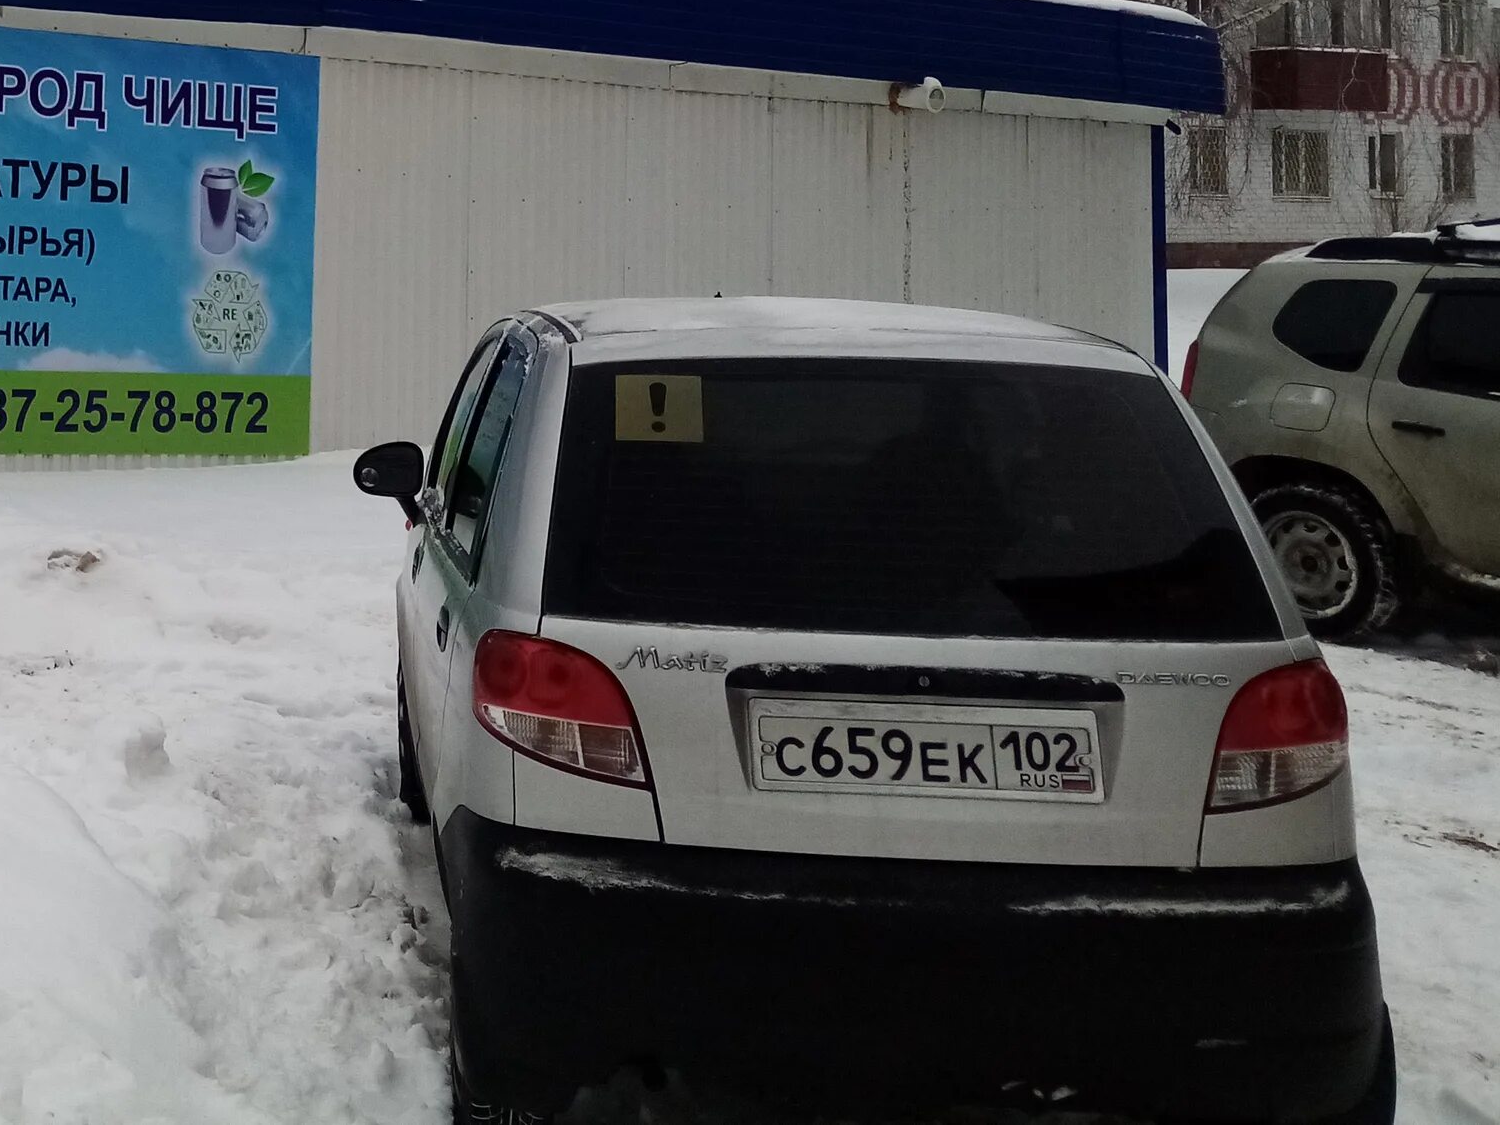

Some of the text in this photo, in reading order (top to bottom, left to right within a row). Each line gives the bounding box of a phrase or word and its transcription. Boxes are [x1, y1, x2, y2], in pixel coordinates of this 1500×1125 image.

[123, 75, 278, 140] ЧИЩЕ
[222, 308, 238, 321] RE
[615, 646, 728, 673] Matiz
[1116, 671, 1230, 687] DAEWOO
[776, 726, 1080, 784] С659ЕК 102
[1020, 773, 1060, 789] RUS
